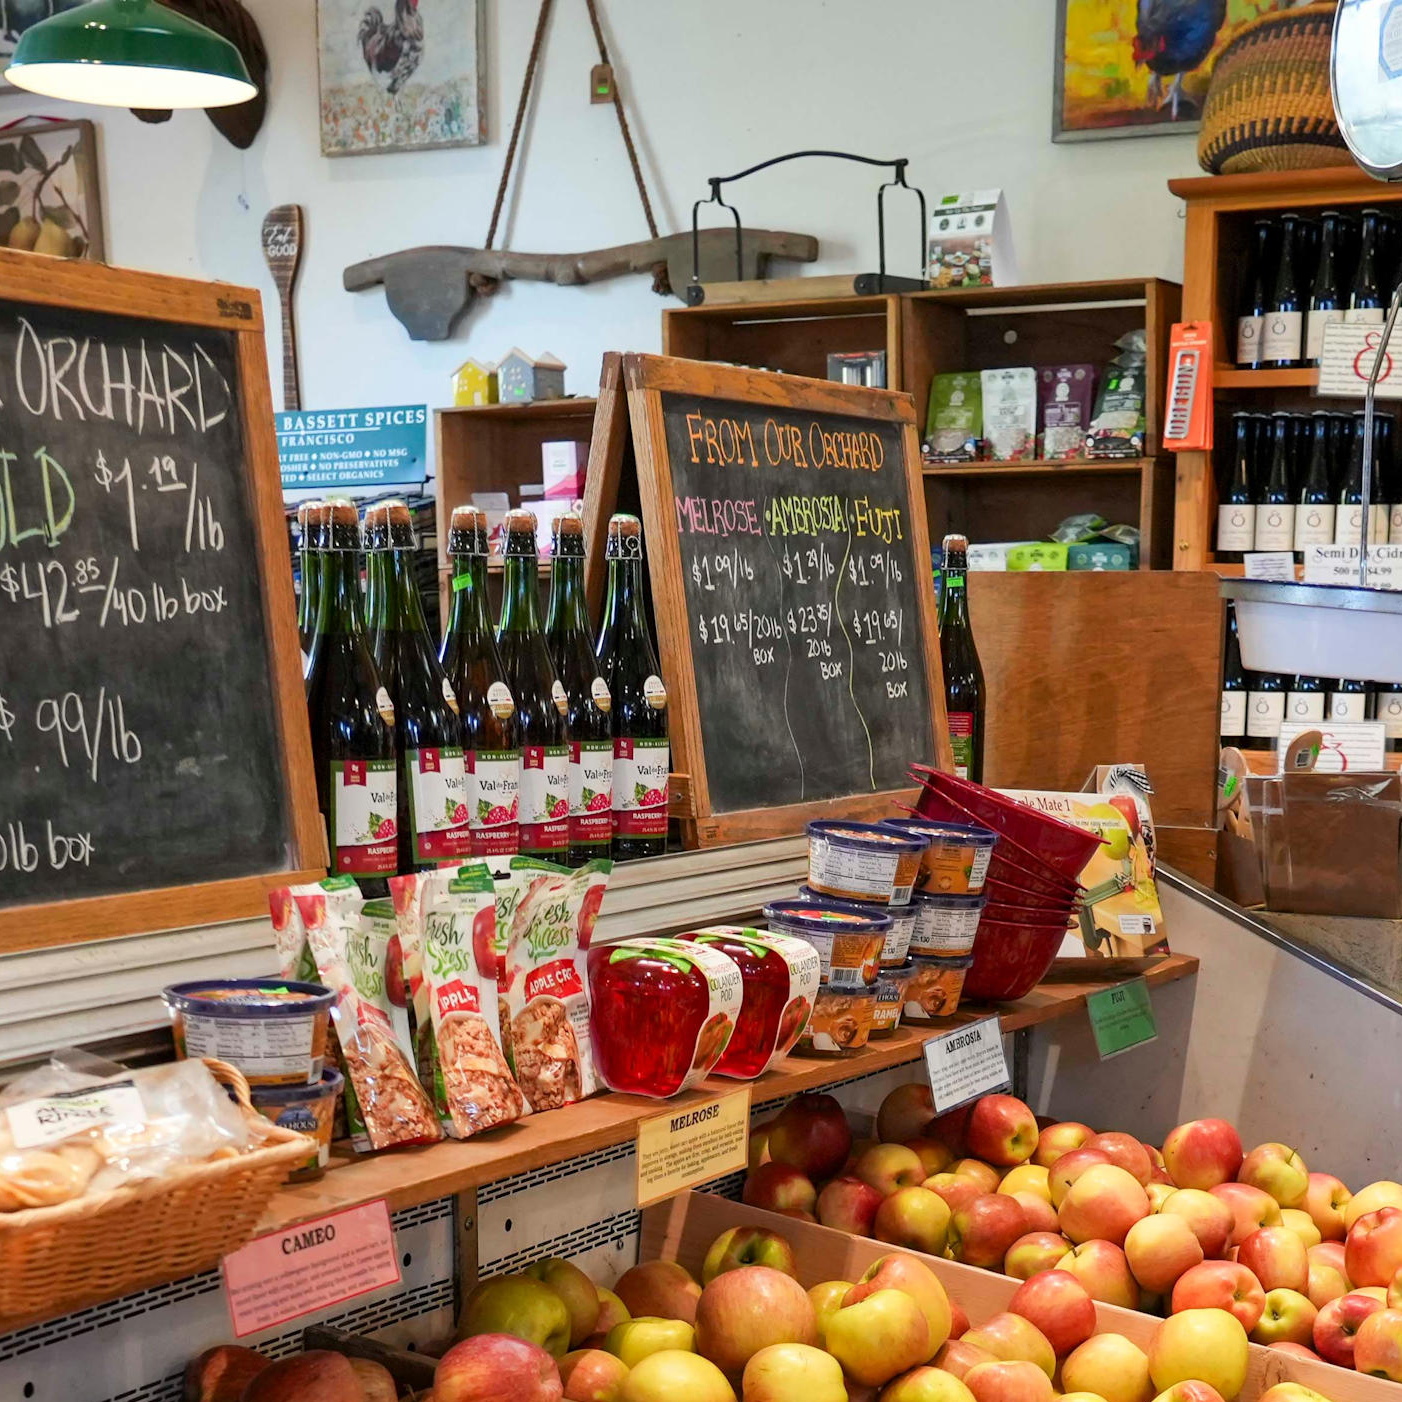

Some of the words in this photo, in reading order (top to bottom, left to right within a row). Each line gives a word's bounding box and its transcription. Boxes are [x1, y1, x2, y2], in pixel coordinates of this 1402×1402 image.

[268, 244, 297, 256] GOOD
[17, 316, 229, 435] ORCHARD
[284, 413, 358, 430] BASSETT
[365, 410, 425, 426] SPICES
[282, 433, 355, 447] FRANCISCO
[686, 410, 759, 468] FROM
[764, 418, 808, 468] OUR
[809, 422, 885, 471] ORCHARD
[296, 452, 309, 462] FREE
[320, 451, 362, 460] NON-GMO
[373, 450, 386, 458] NO
[388, 448, 408, 457] MSG
[280, 463, 308, 472] OSHER
[318, 462, 331, 470] NO
[334, 459, 398, 470] PRESERVATIVES
[307, 472, 337, 481] SELECT
[338, 470, 384, 480] ORGANICS
[675, 496, 762, 538] MELROSE
[770, 496, 848, 536] AMBROSIA
[854, 496, 903, 545] FUJI
[1316, 548, 1345, 558] Semi
[1334, 567, 1349, 575] 500
[184, 575, 228, 614] box
[753, 648, 775, 665] BOX
[820, 662, 842, 680] BOX
[886, 681, 907, 698] BOX
[584, 770, 598, 780] Val
[638, 765, 651, 775] Val
[446, 778, 458, 789] Val
[480, 780, 496, 791] Val
[548, 776, 560, 785] Val
[371, 792, 386, 803] Val
[1036, 798, 1063, 812] Mate
[1065, 799, 1070, 811] 1
[476, 832, 510, 840] RASPBERRY
[51, 833, 95, 872] box
[790, 956, 819, 976] COLANDER
[529, 975, 554, 995] APPLE
[709, 971, 742, 992] COLANDER
[799, 972, 811, 985] POD
[720, 988, 733, 1002] POD
[1111, 991, 1125, 1004] FUJI
[945, 1030, 982, 1054] AMBROSIA
[670, 1104, 720, 1133] MELROSE
[281, 1224, 336, 1255] CAMEO
